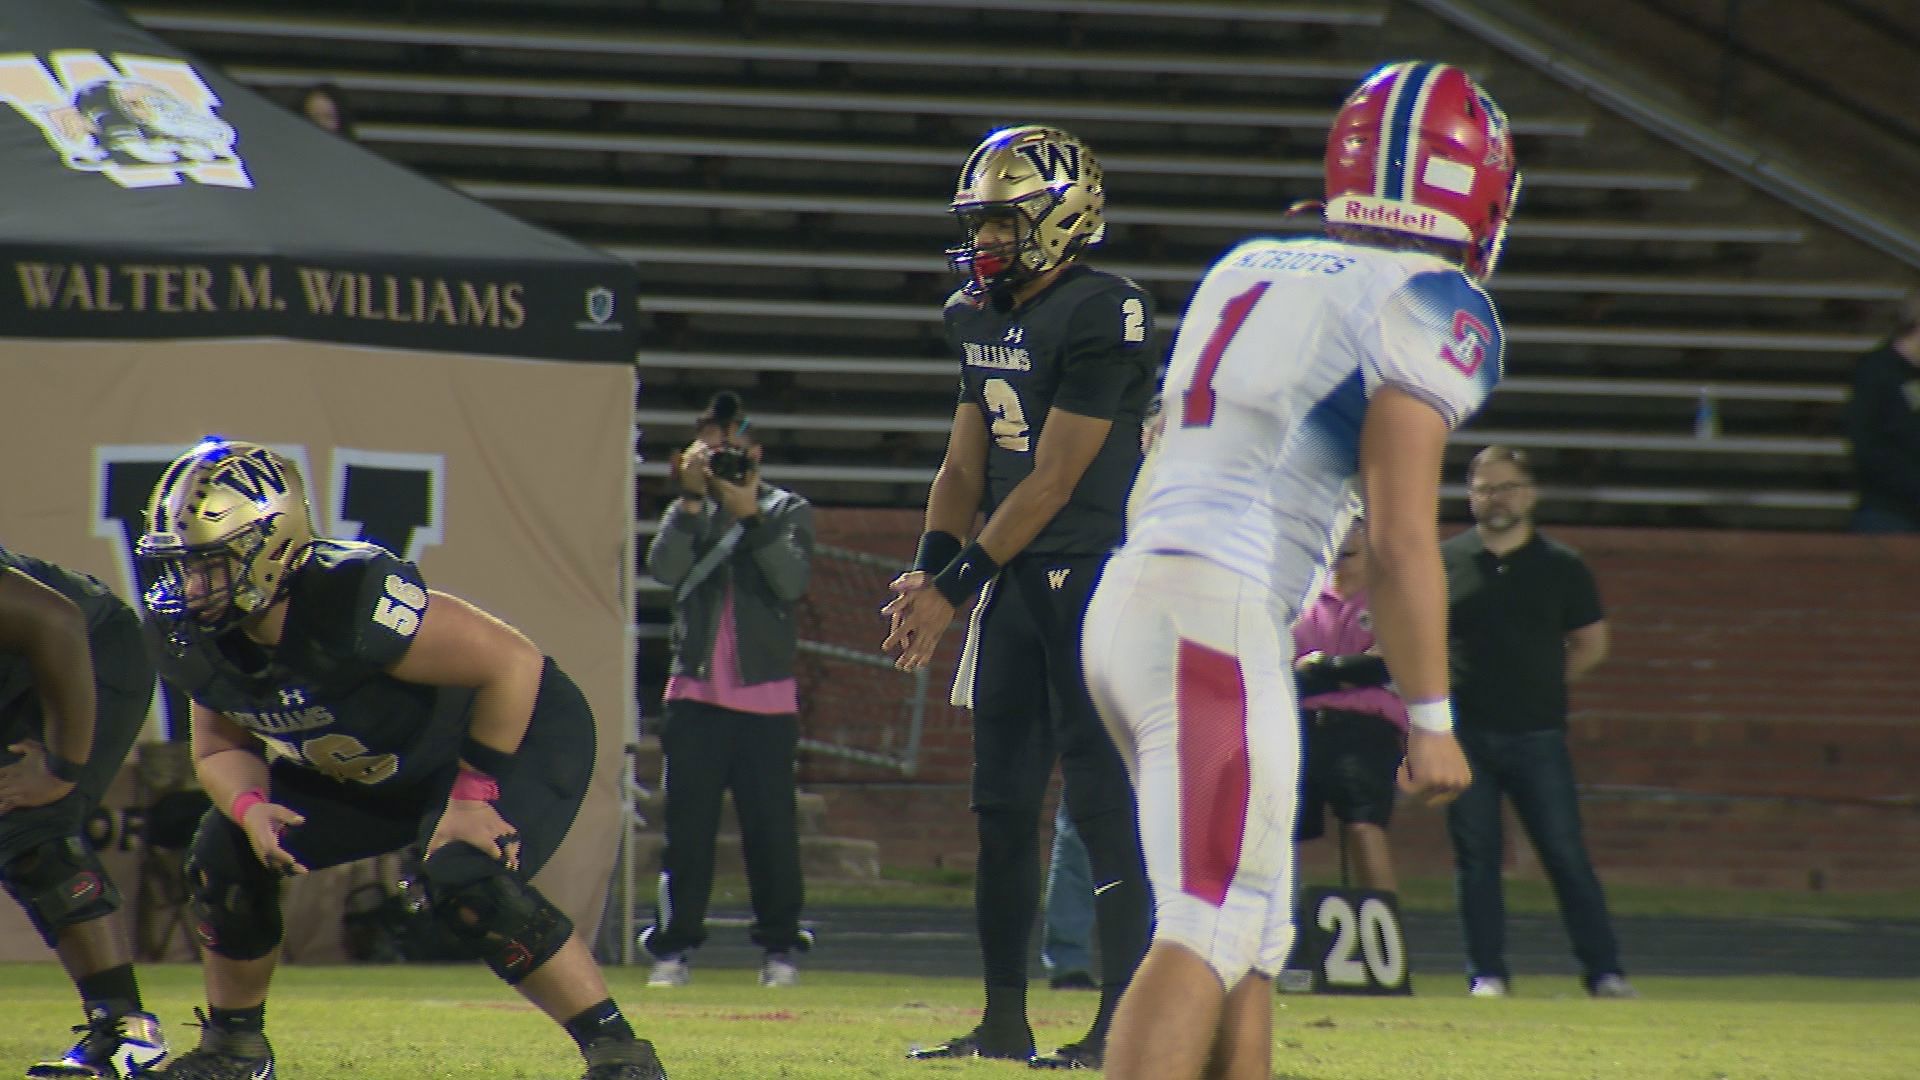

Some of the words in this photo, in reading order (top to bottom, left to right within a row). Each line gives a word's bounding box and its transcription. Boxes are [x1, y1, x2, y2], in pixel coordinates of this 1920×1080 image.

[1014, 140, 1082, 184] W
[1344, 199, 1438, 232] Riddell
[15, 261, 218, 312] WALTER
[229, 263, 287, 311] M.
[297, 266, 525, 329] WILLIAMS
[1121, 297, 1146, 343] 2
[1181, 280, 1273, 429] 1
[982, 378, 1031, 452] 2
[210, 448, 289, 511] W
[372, 572, 430, 638] 56
[1046, 567, 1072, 591] W
[1316, 895, 1409, 989] 20
